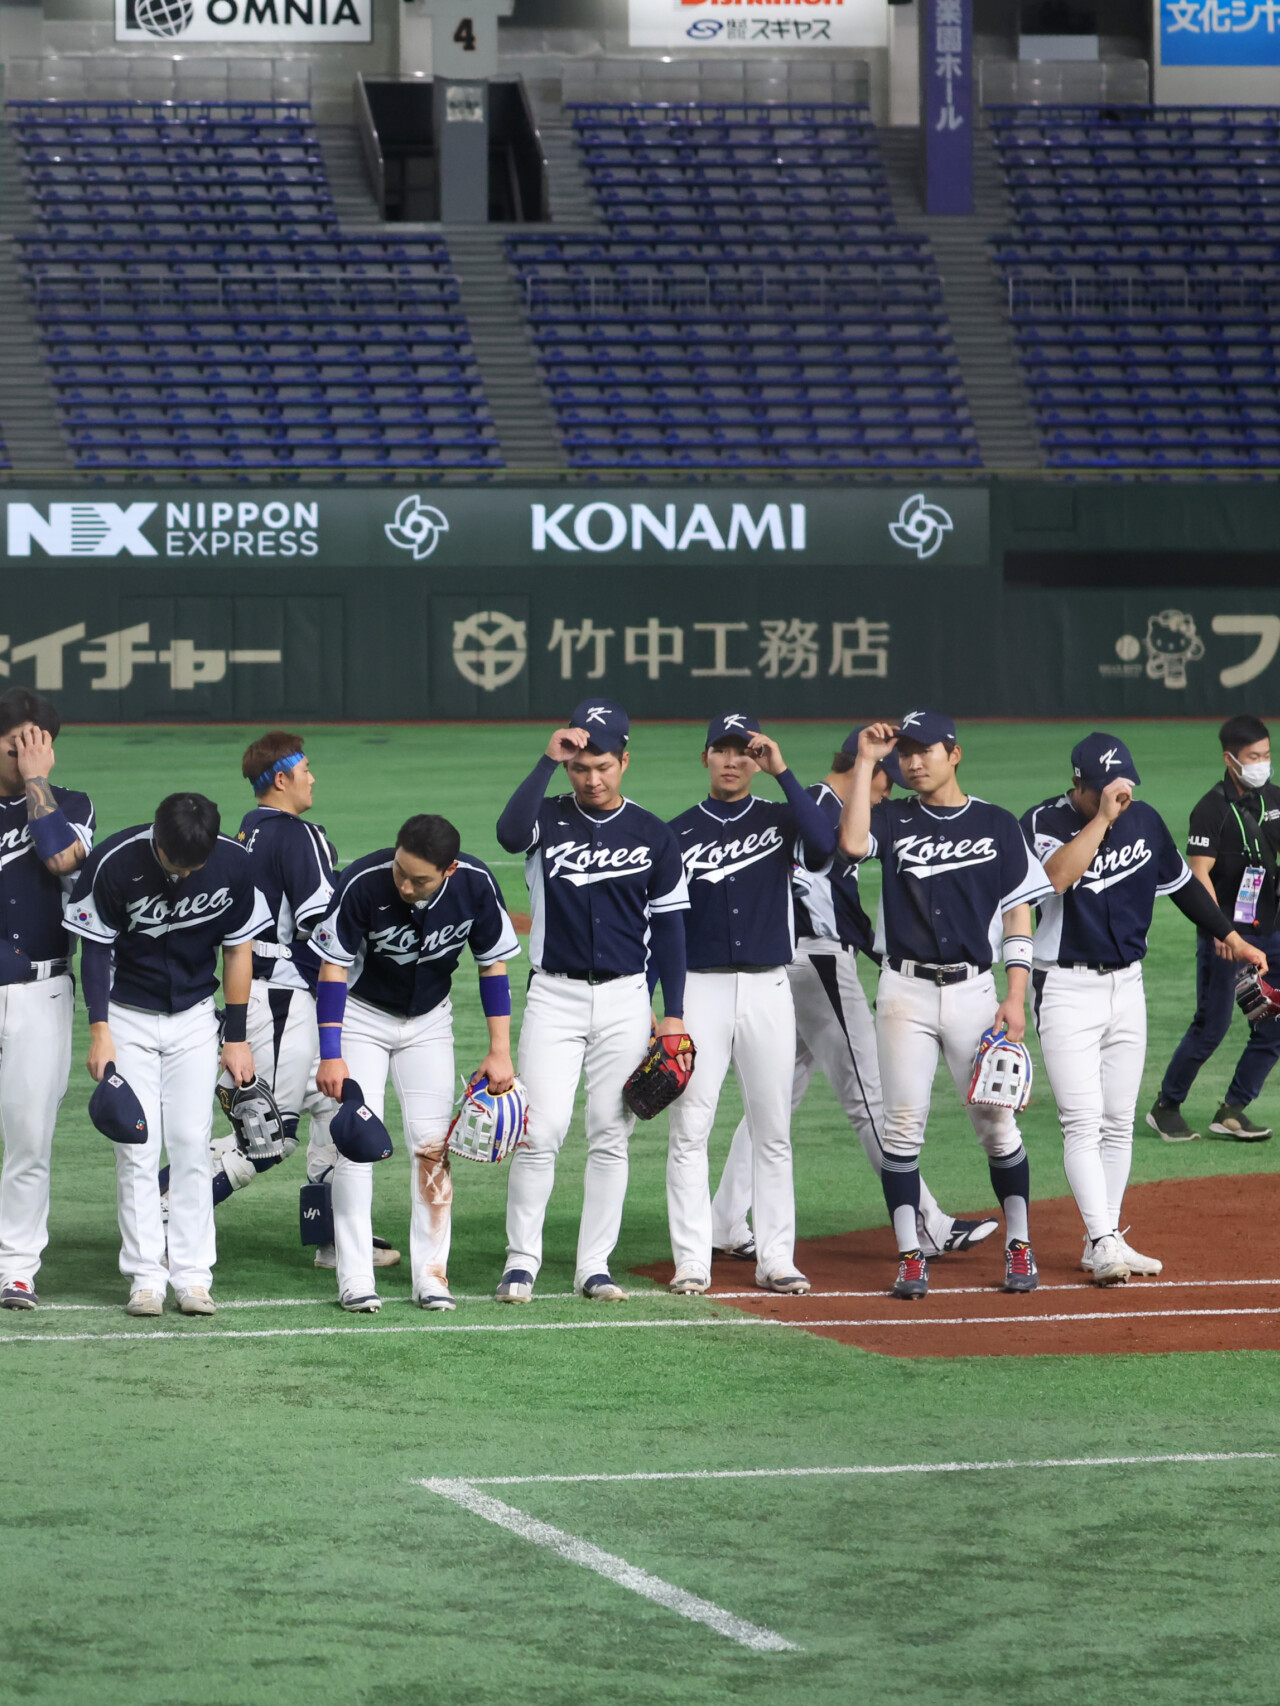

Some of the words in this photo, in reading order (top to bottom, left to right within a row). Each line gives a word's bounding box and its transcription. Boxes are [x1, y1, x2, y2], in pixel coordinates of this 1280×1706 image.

[453, 18, 476, 51] 4
[751, 18, 831, 40] スギヤス
[167, 501, 319, 529] NIPPON
[531, 503, 807, 552] KONAMI
[167, 531, 319, 556] EXPRESS
[547, 617, 891, 679] 竹中工務店
[545, 840, 653, 887] Korea
[681, 826, 783, 884] Korea
[893, 835, 997, 879] Korea
[126, 887, 234, 938] Korea
[368, 919, 475, 966] Korea
